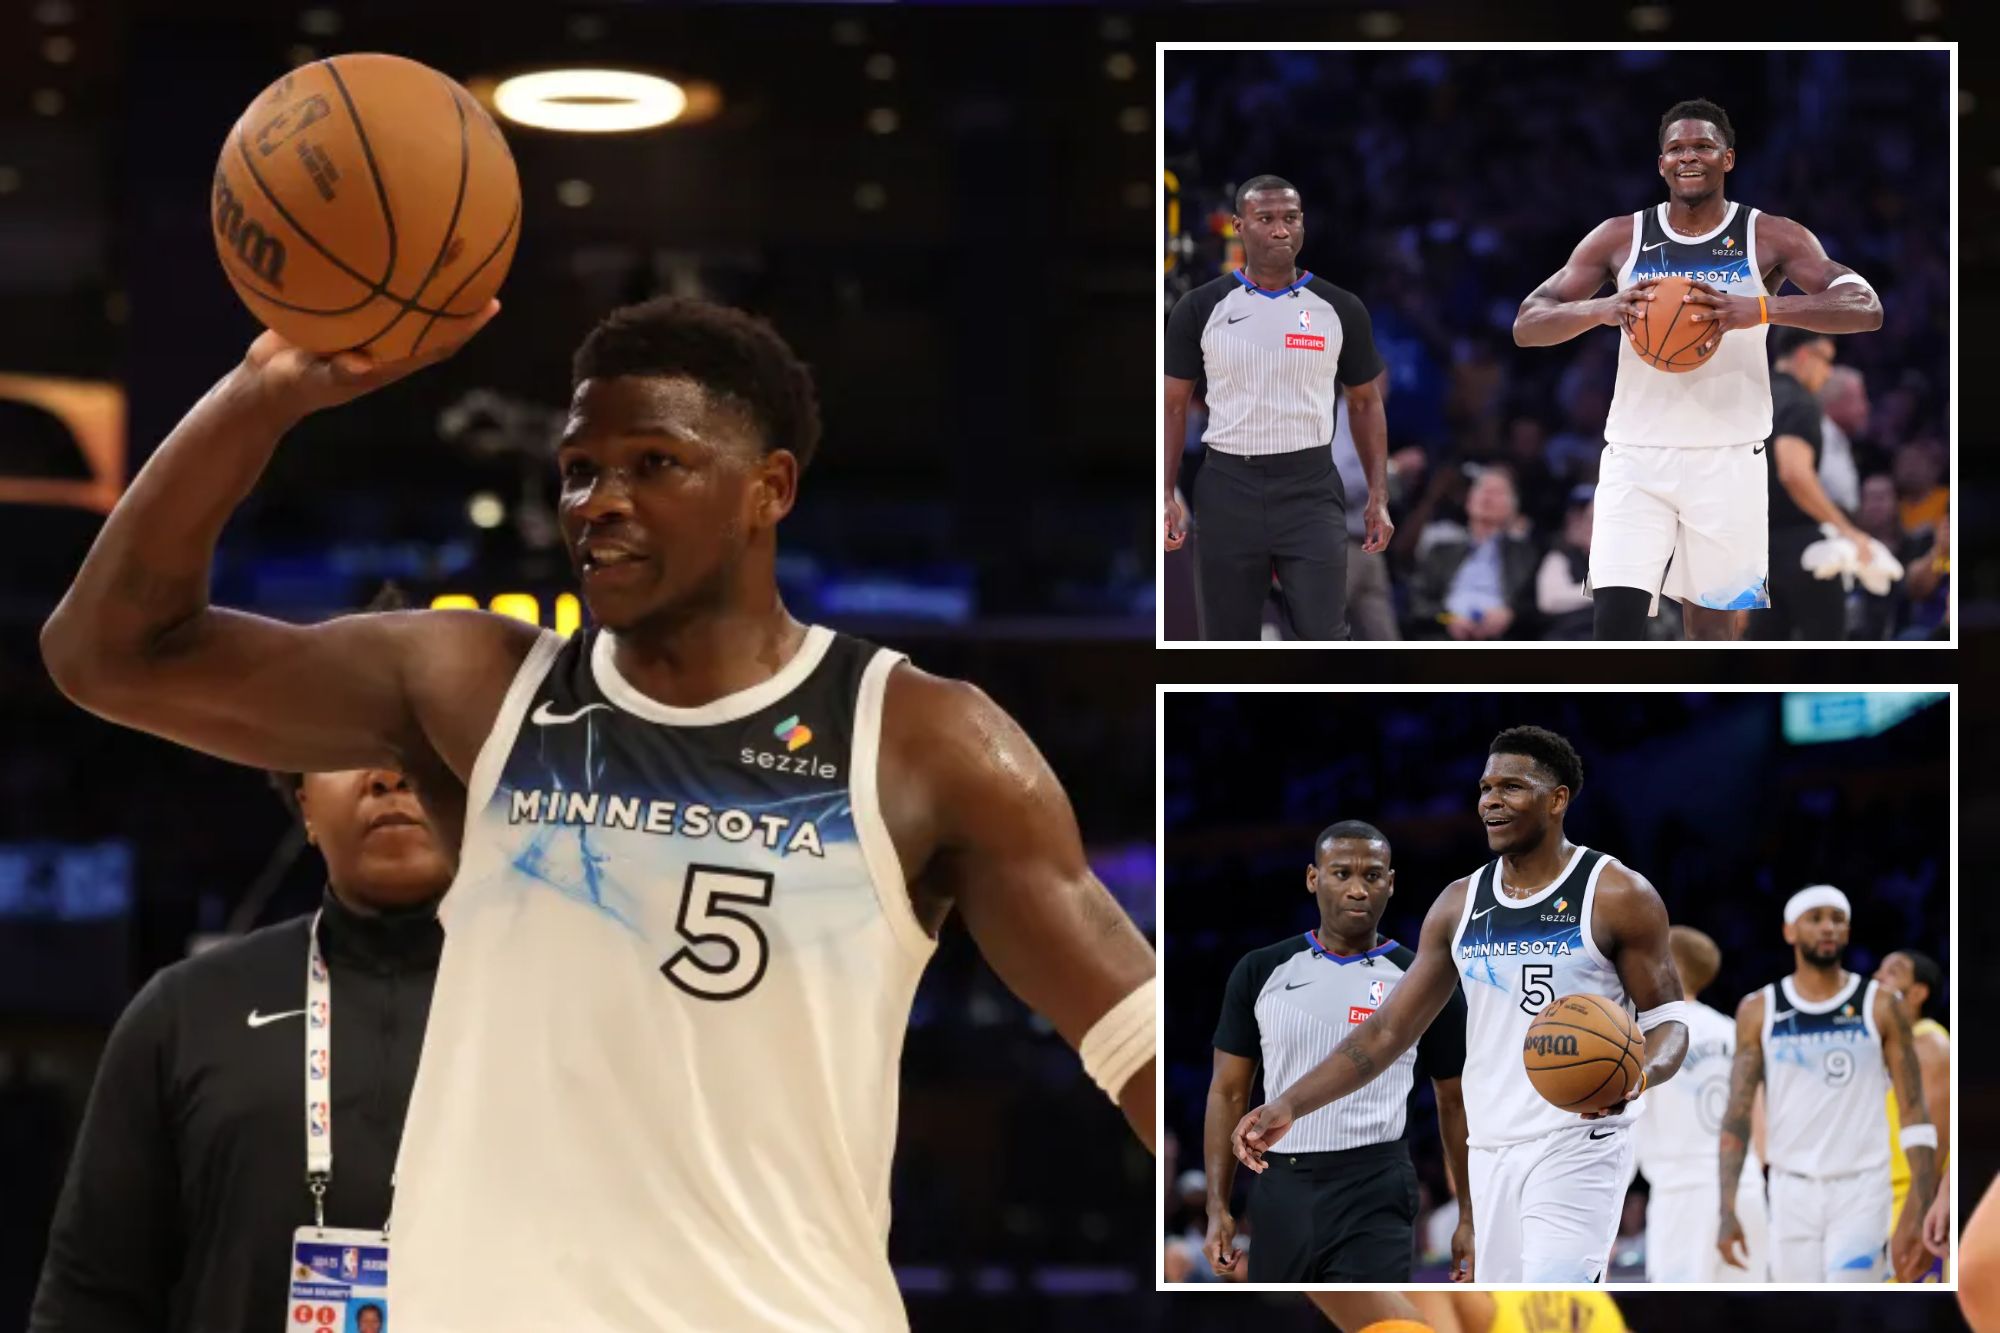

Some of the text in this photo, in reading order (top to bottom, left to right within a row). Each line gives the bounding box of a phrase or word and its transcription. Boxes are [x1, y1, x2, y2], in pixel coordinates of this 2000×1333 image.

[1712, 248, 1744, 257] sezzle
[1286, 336, 1325, 348] Emirates
[740, 746, 837, 780] sezzle
[508, 789, 825, 857] MINNESOTA
[660, 863, 775, 1001] 5
[1540, 913, 1576, 923] sezzle
[1462, 941, 1572, 959] MINNESOTA
[1519, 964, 1555, 1016] 5
[1823, 1047, 1856, 1089] 9
